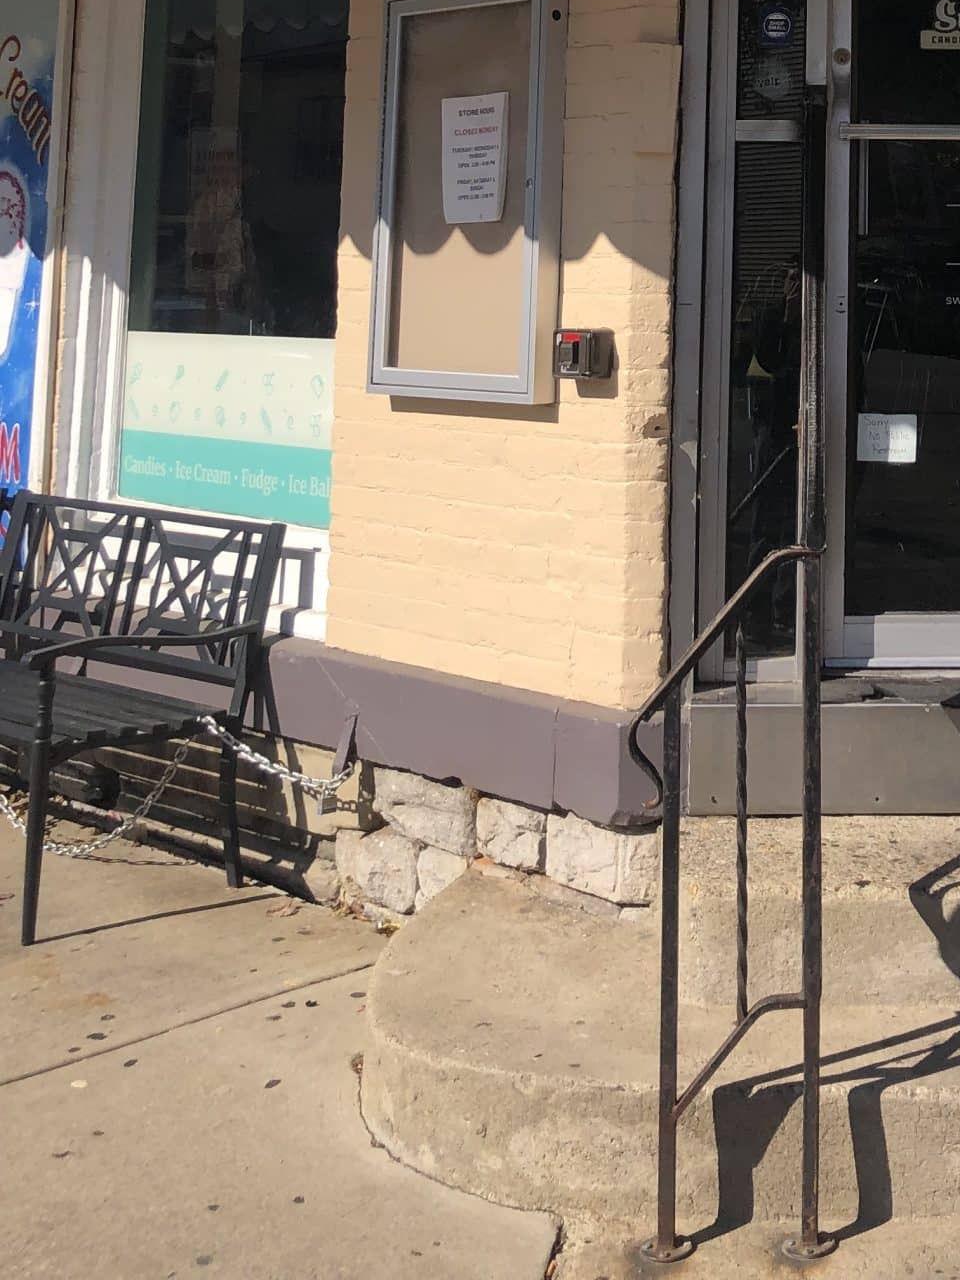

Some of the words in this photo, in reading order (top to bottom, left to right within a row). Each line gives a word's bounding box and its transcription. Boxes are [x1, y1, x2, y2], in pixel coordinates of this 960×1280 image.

[123, 454, 166, 476] Candies
[175, 460, 192, 481] Ice
[194, 463, 231, 485] Cream
[241, 468, 278, 496] Fudge
[288, 473, 307, 495] Ice
